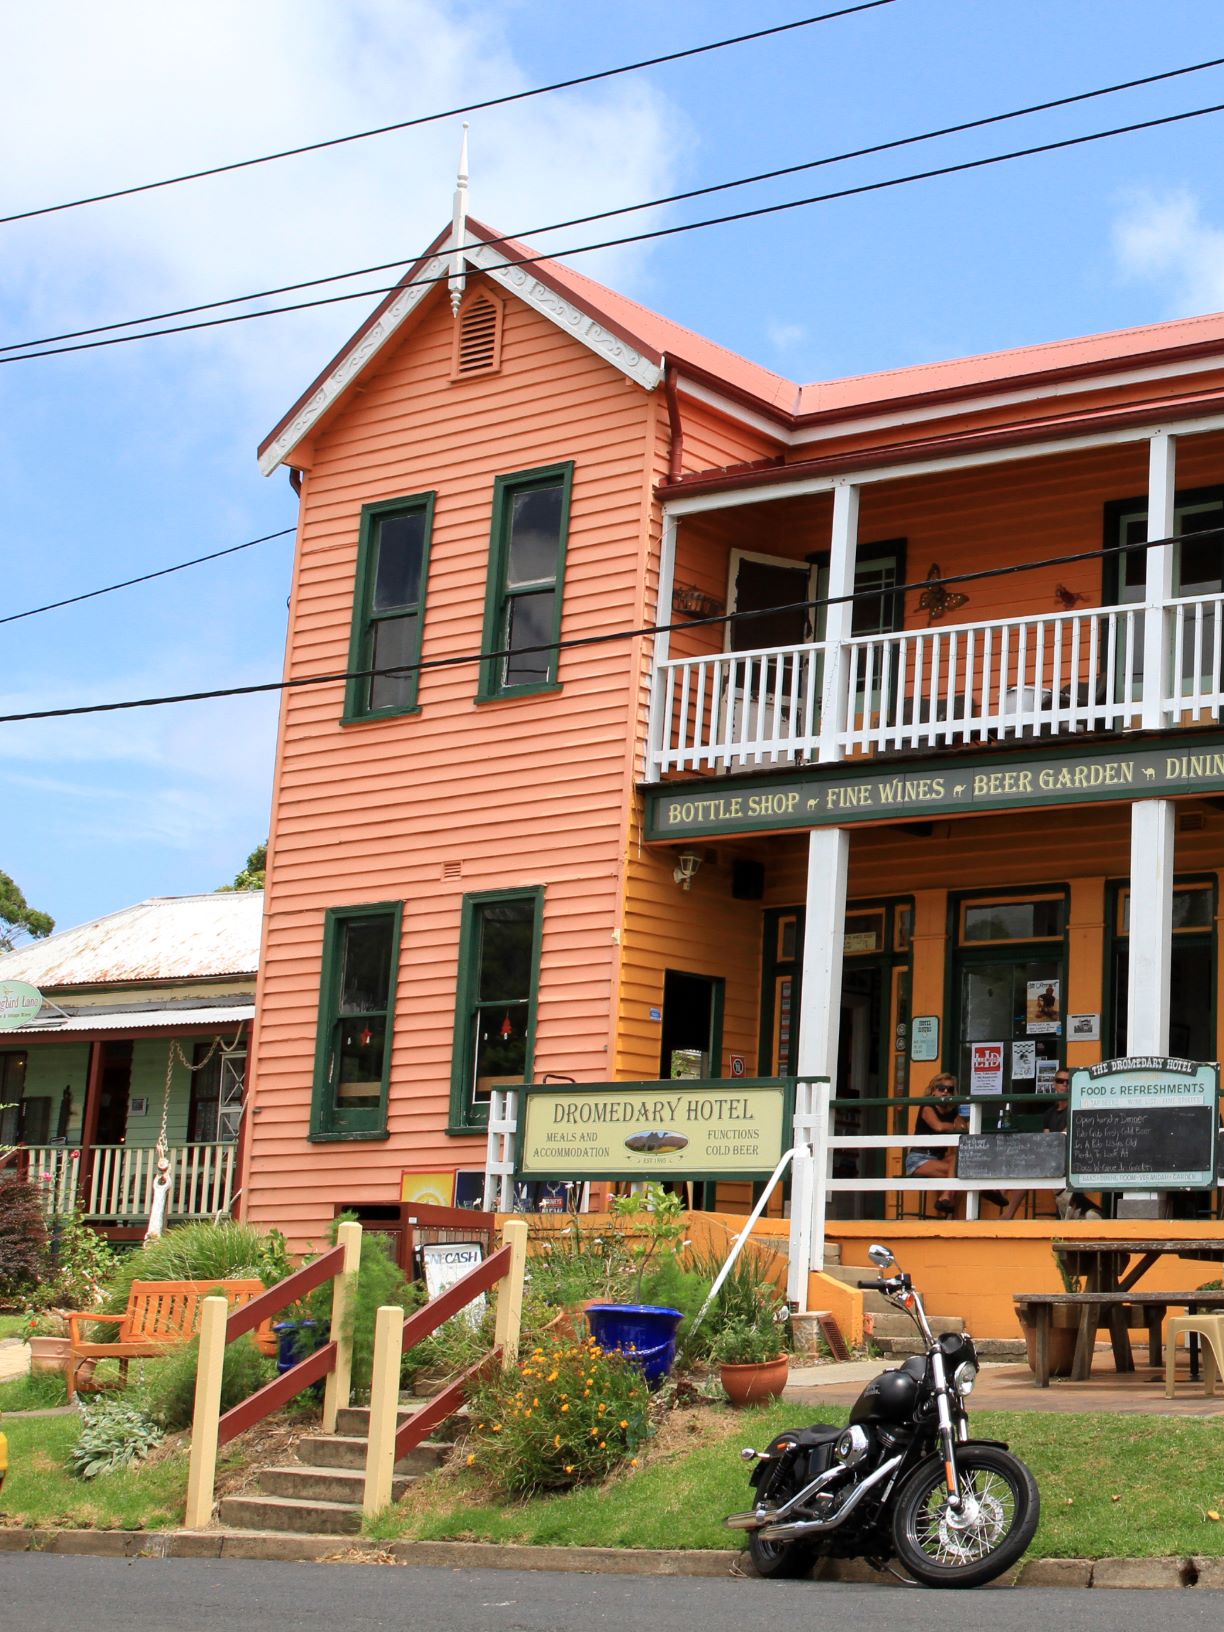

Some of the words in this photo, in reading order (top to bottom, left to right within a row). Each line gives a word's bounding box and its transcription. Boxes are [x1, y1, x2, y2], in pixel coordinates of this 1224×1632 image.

[668, 796, 744, 825] BOTTLE
[747, 791, 799, 817] SHOP
[827, 784, 871, 809] FINE
[879, 775, 945, 804] WINES
[973, 769, 1033, 797] BEER
[1038, 761, 1135, 790] GARDEN
[1091, 1063, 1109, 1076] THE
[1111, 1057, 1165, 1071] DROMEDARY
[1166, 1058, 1193, 1073] HOTEL
[1080, 1086, 1107, 1096] FOOD
[1120, 1083, 1205, 1095] REFRESHMENTS
[552, 1097, 683, 1125] DROMEDARY
[687, 1098, 754, 1121] HOTEL
[546, 1132, 577, 1143] MEALS
[579, 1131, 598, 1142] AND
[707, 1129, 760, 1140] FUNCTIONS
[533, 1146, 610, 1158] ACCOMMODATION
[705, 1145, 731, 1156] COLD
[732, 1145, 759, 1156] BEER
